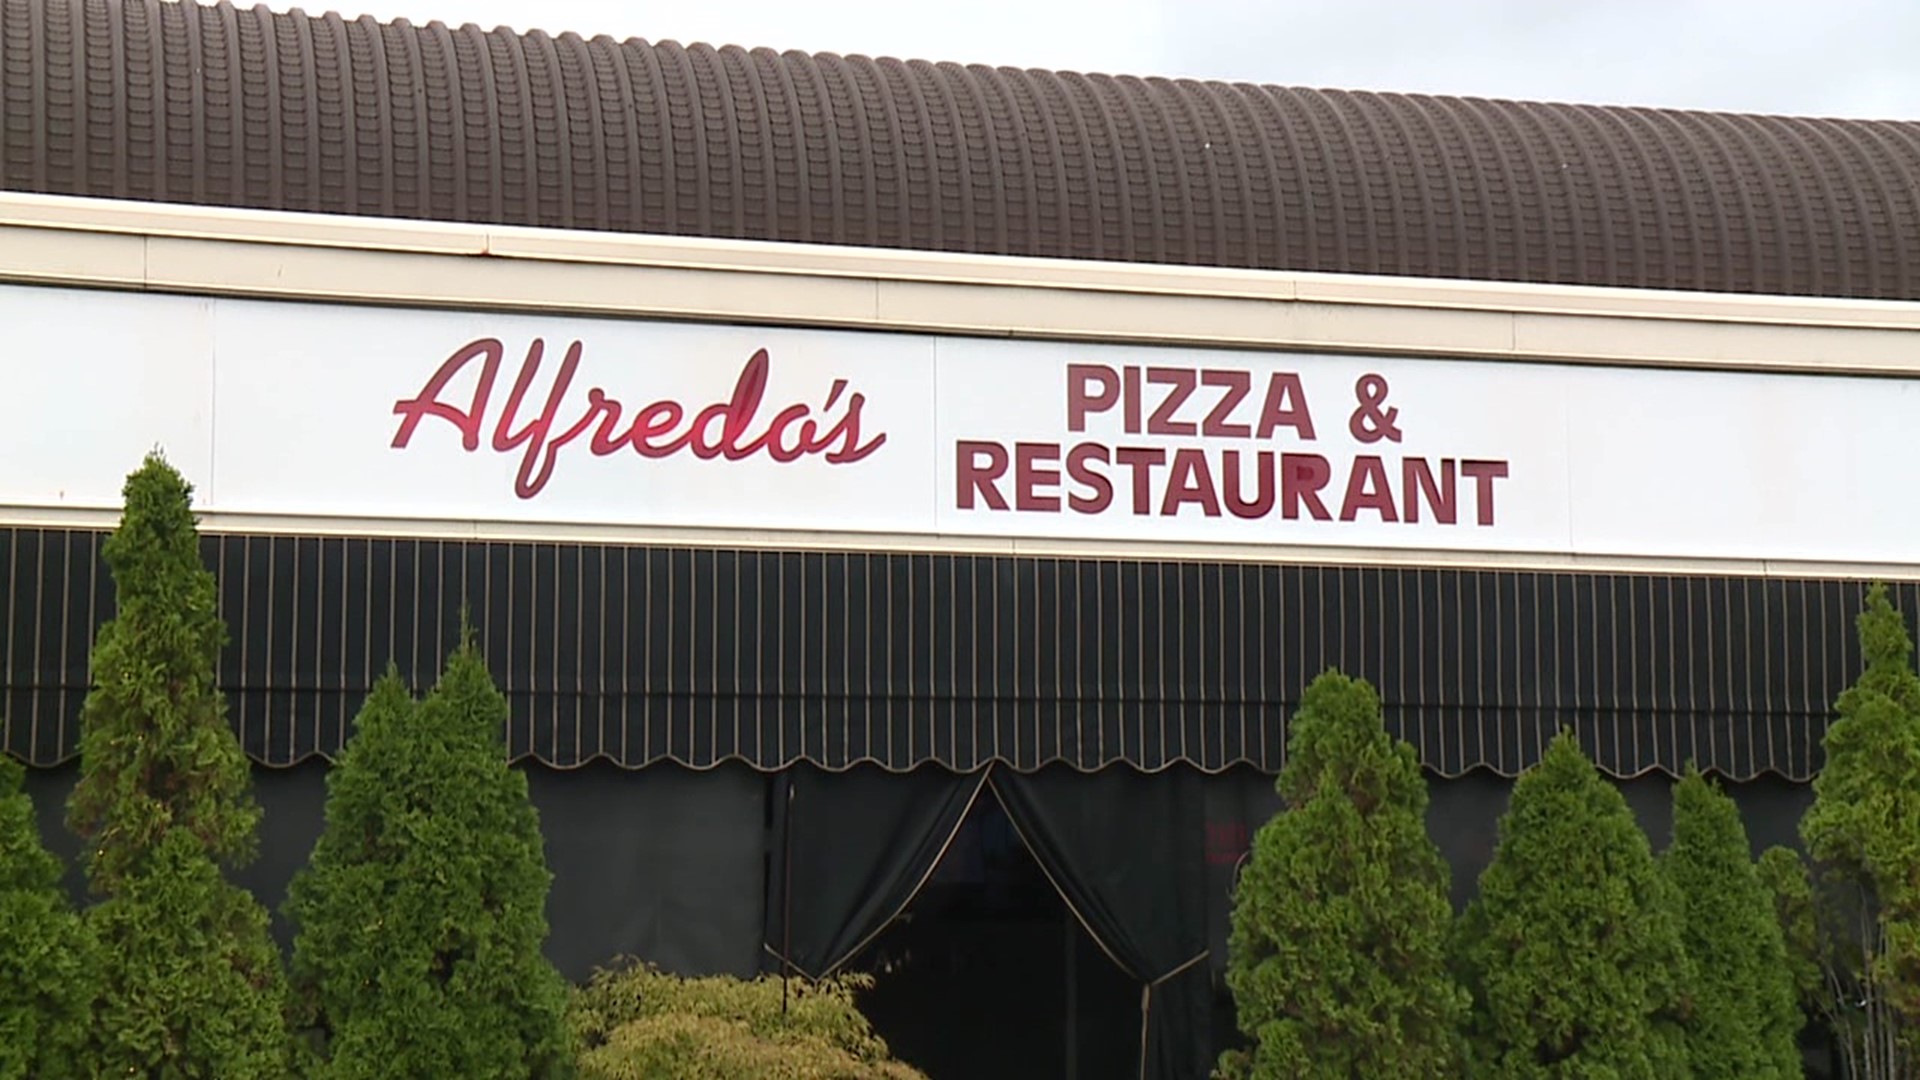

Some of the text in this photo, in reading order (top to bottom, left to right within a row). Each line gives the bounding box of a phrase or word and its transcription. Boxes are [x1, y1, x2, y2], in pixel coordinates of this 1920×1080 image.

[391, 338, 887, 500] Alfredo's
[1068, 363, 1402, 444] PIZZA &
[957, 440, 1509, 526] RESTAURANT
